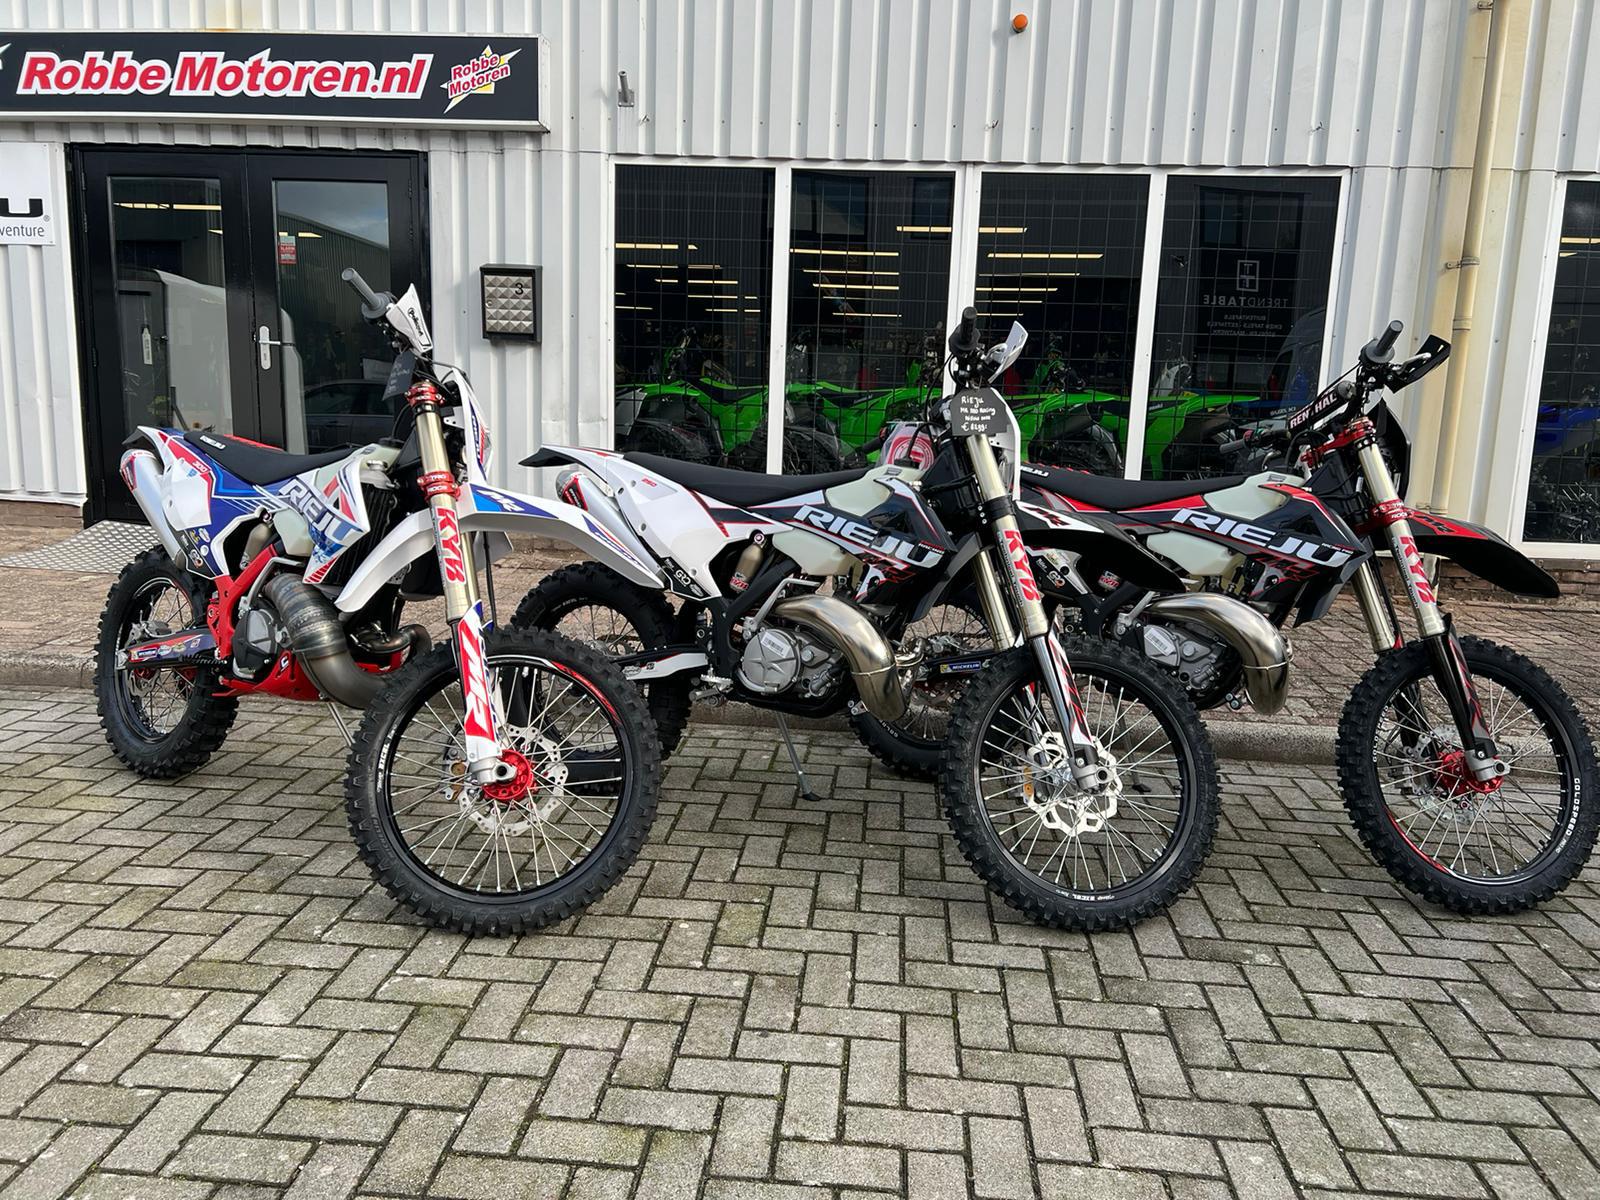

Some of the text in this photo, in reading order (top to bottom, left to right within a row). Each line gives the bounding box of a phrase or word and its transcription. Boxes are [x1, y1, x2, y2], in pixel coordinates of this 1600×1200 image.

[18, 51, 431, 98] Robbe Motoren.nl
[448, 64, 511, 98] Motoren
[451, 54, 500, 80] Robbe
[514, 282, 524, 295] 3
[435, 506, 466, 584] KYB
[793, 504, 944, 569] RIEJU
[1003, 529, 1041, 602] KYB
[1171, 507, 1353, 568] RIEJU
[1398, 535, 1437, 603] KYB
[1565, 777, 1581, 836] GOLDSPEED
